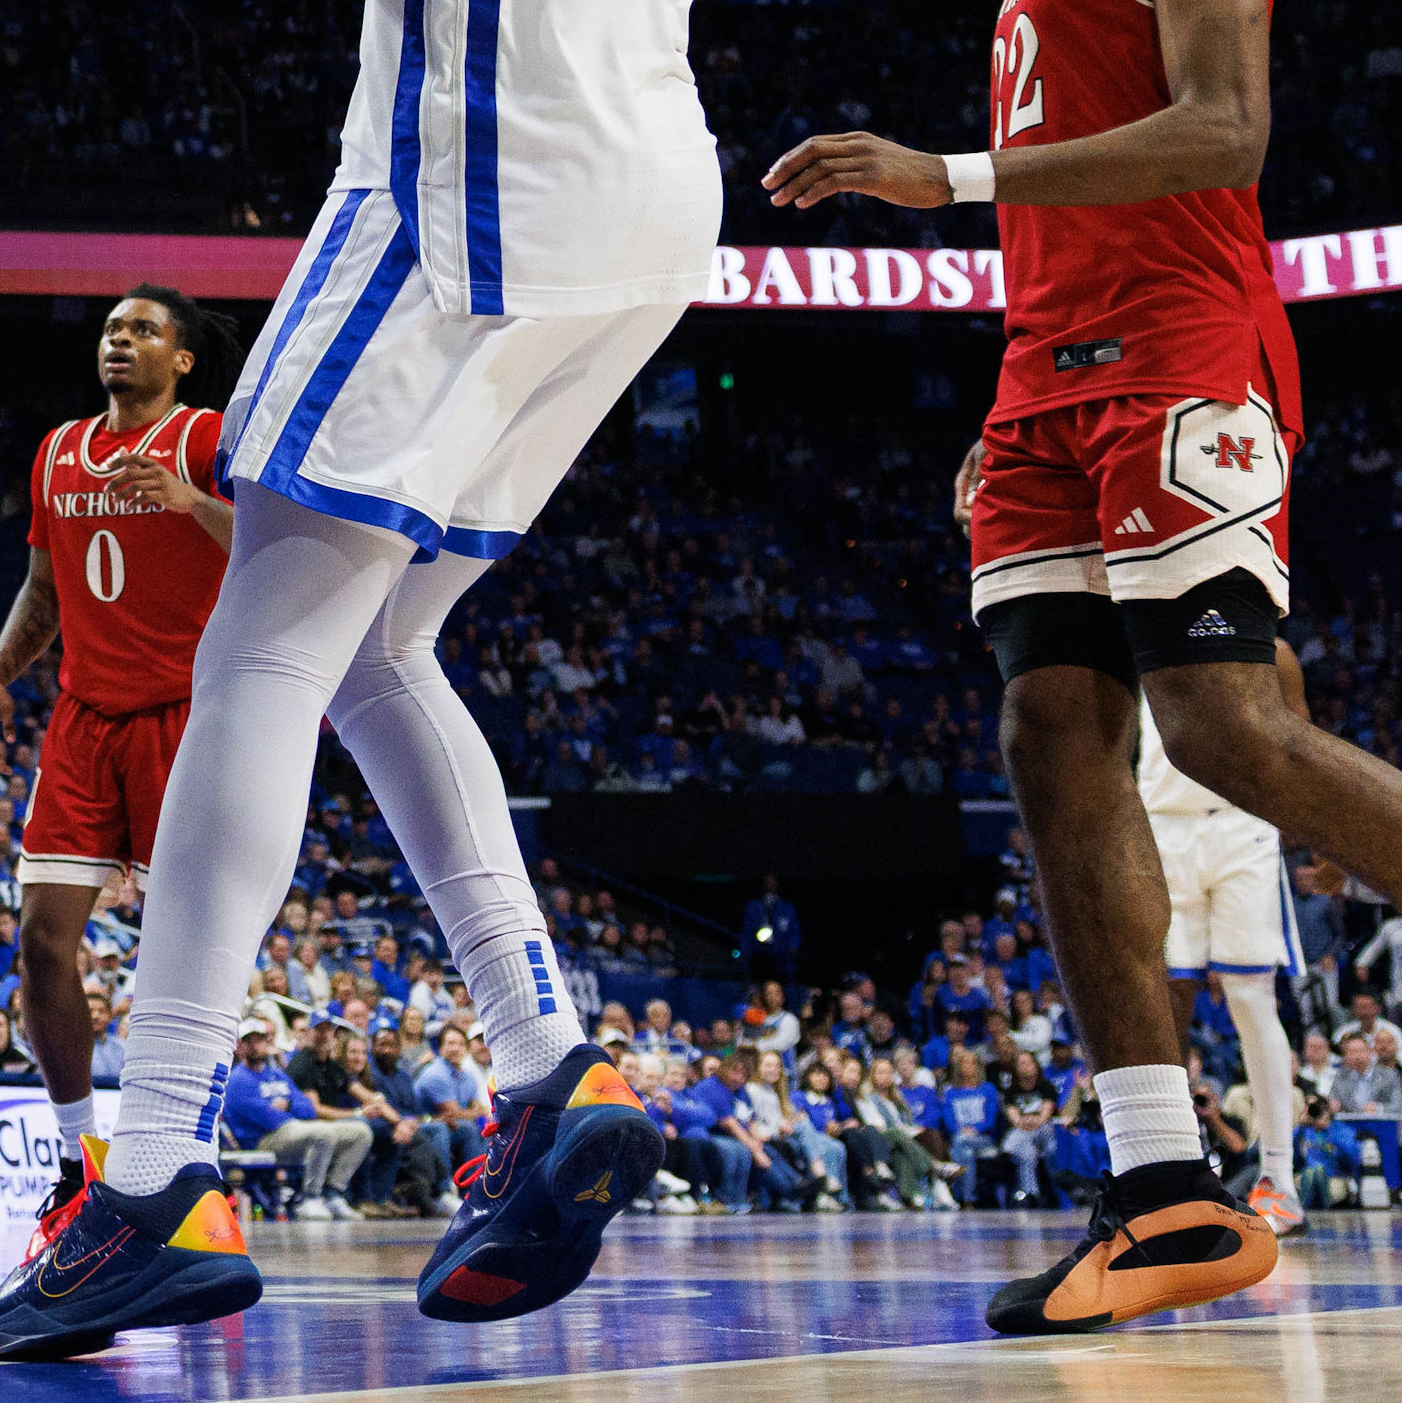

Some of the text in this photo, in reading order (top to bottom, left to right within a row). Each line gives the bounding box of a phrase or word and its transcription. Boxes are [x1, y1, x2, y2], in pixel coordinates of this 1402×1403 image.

[708, 224, 1402, 308] BARDST TH
[85, 528, 126, 603] 0
